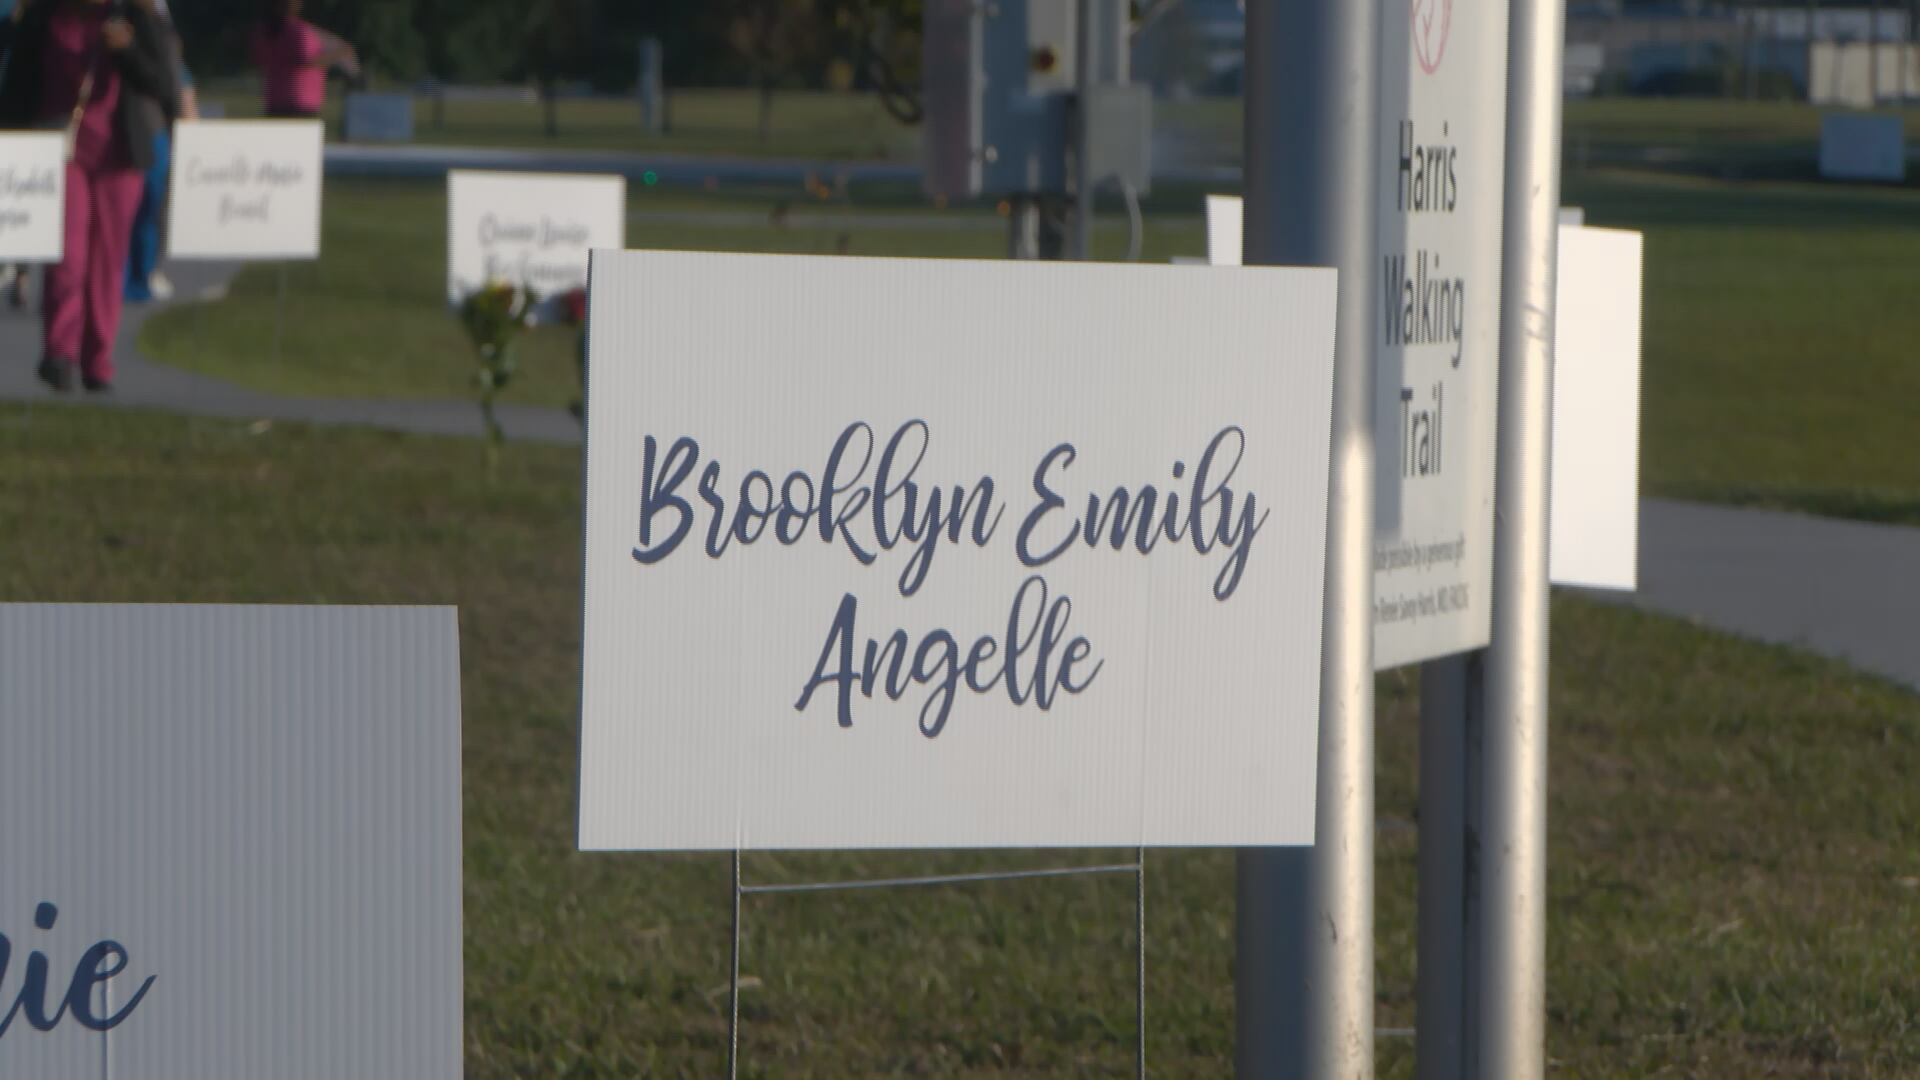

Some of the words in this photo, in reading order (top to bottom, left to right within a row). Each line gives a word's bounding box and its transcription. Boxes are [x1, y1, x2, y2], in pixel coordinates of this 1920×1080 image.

[1398, 120, 1457, 212] Harris
[1384, 250, 1465, 369] Walking
[1401, 381, 1444, 478] Trail
[632, 419, 1005, 597] Brooklyn
[1016, 426, 1270, 602] Emily
[794, 575, 1105, 739] Angelle
[0, 902, 157, 1038] ie
